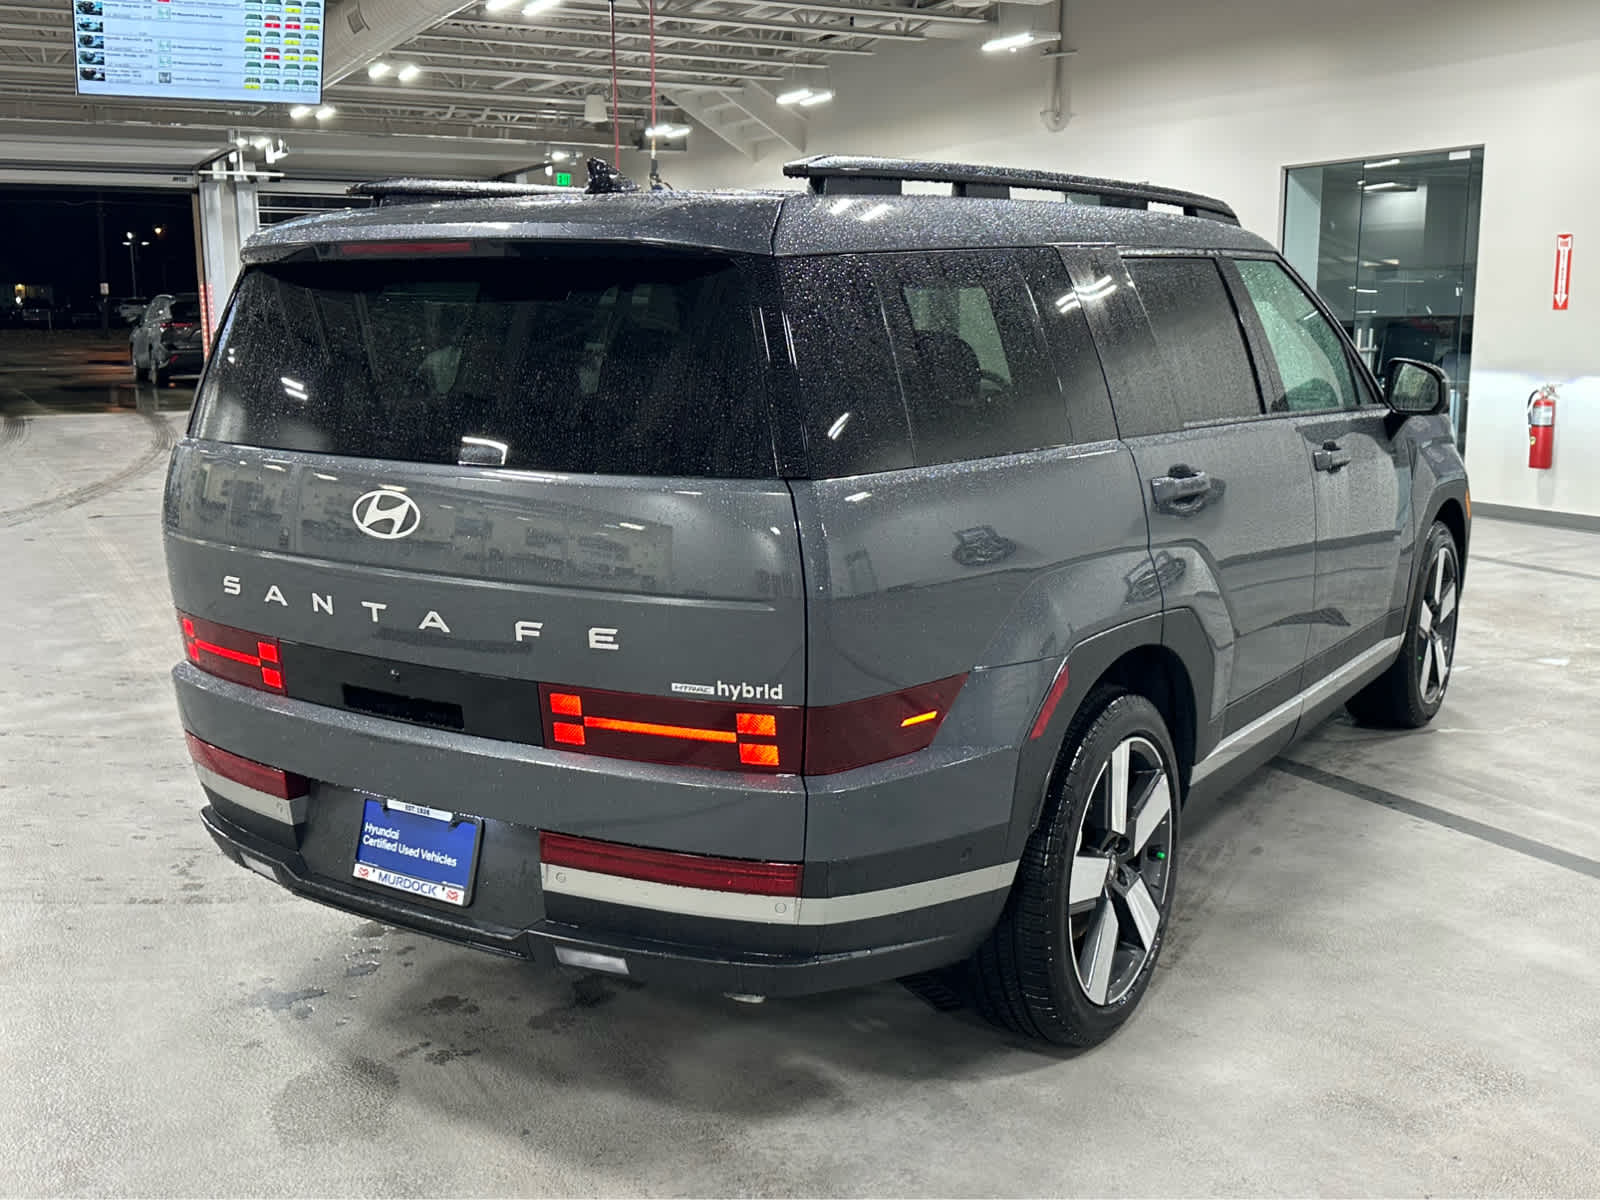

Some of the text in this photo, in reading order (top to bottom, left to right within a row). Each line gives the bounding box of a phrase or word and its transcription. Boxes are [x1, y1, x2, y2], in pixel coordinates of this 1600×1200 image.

[223, 575, 620, 651] SANTA FE
[717, 680, 783, 701] hybrid
[364, 822, 400, 840] Hyundai
[362, 835, 457, 867] Certified Used Vehicles
[377, 871, 438, 896] MURDOCK
